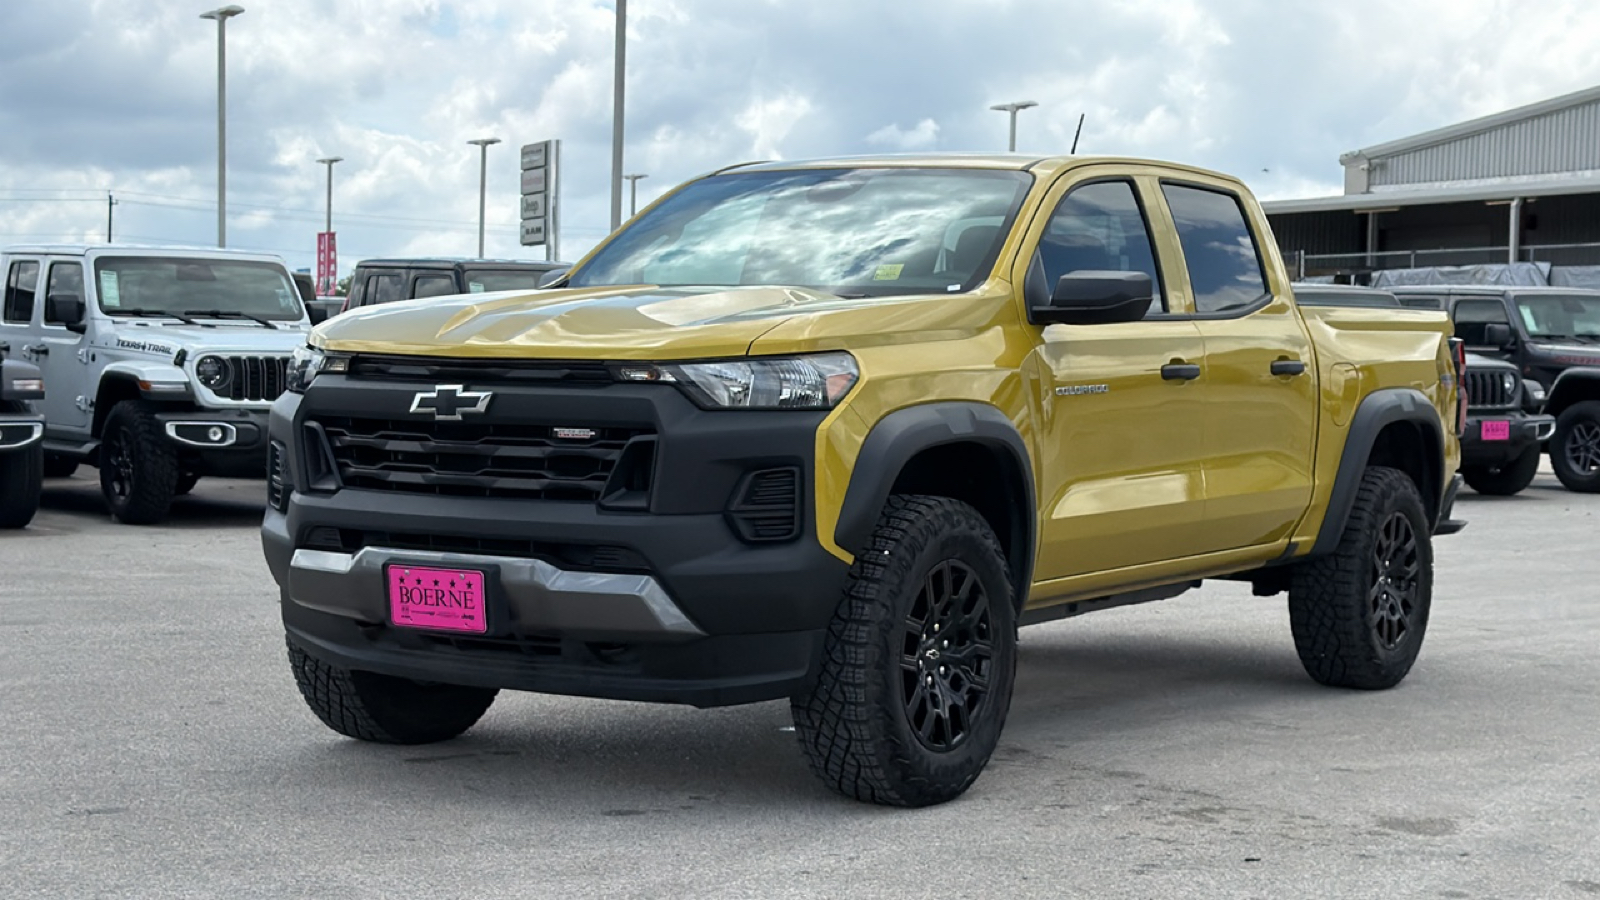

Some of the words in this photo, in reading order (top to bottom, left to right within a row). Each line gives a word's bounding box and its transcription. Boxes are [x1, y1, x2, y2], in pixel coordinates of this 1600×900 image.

[525, 226, 542, 236] RAM
[116, 339, 141, 350] TEXAS
[147, 343, 172, 355] TRAIL
[1055, 385, 1109, 396] COLORADO
[399, 586, 475, 610] BOERNE
